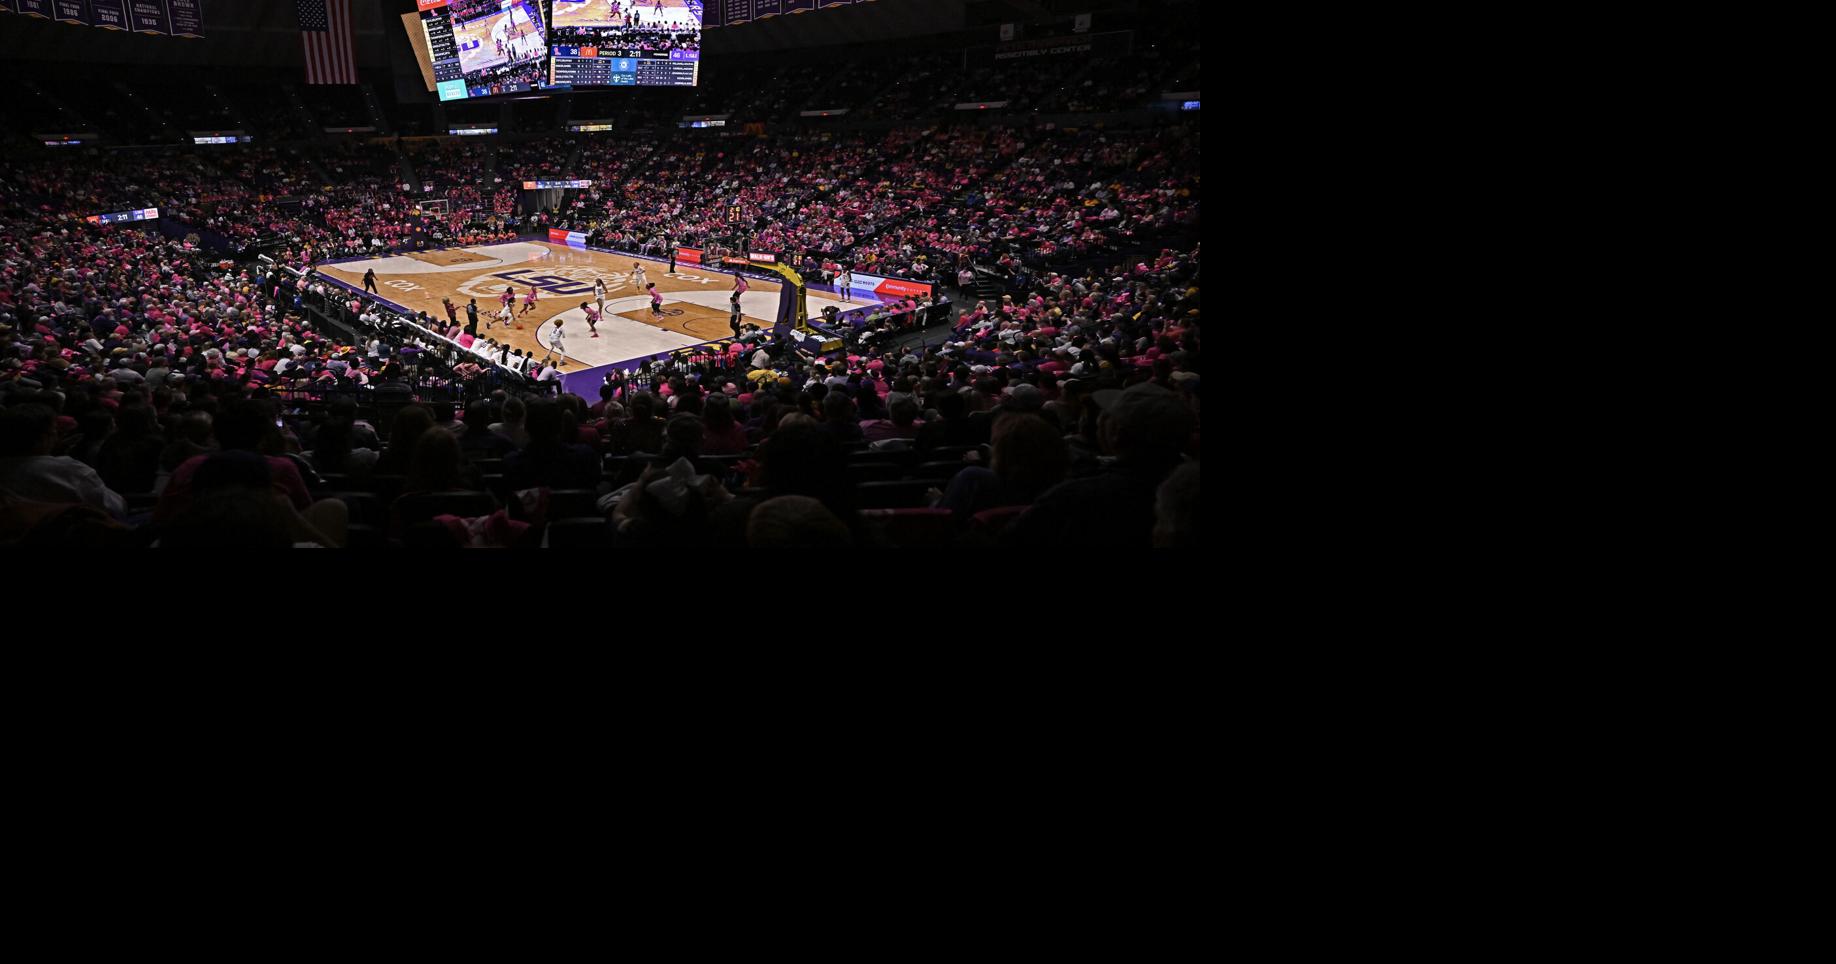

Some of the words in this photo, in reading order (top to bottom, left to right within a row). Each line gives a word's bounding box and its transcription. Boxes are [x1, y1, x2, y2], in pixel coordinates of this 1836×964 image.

[492, 269, 597, 295] LSU
[663, 272, 720, 284] COX
[384, 280, 426, 292] COX
